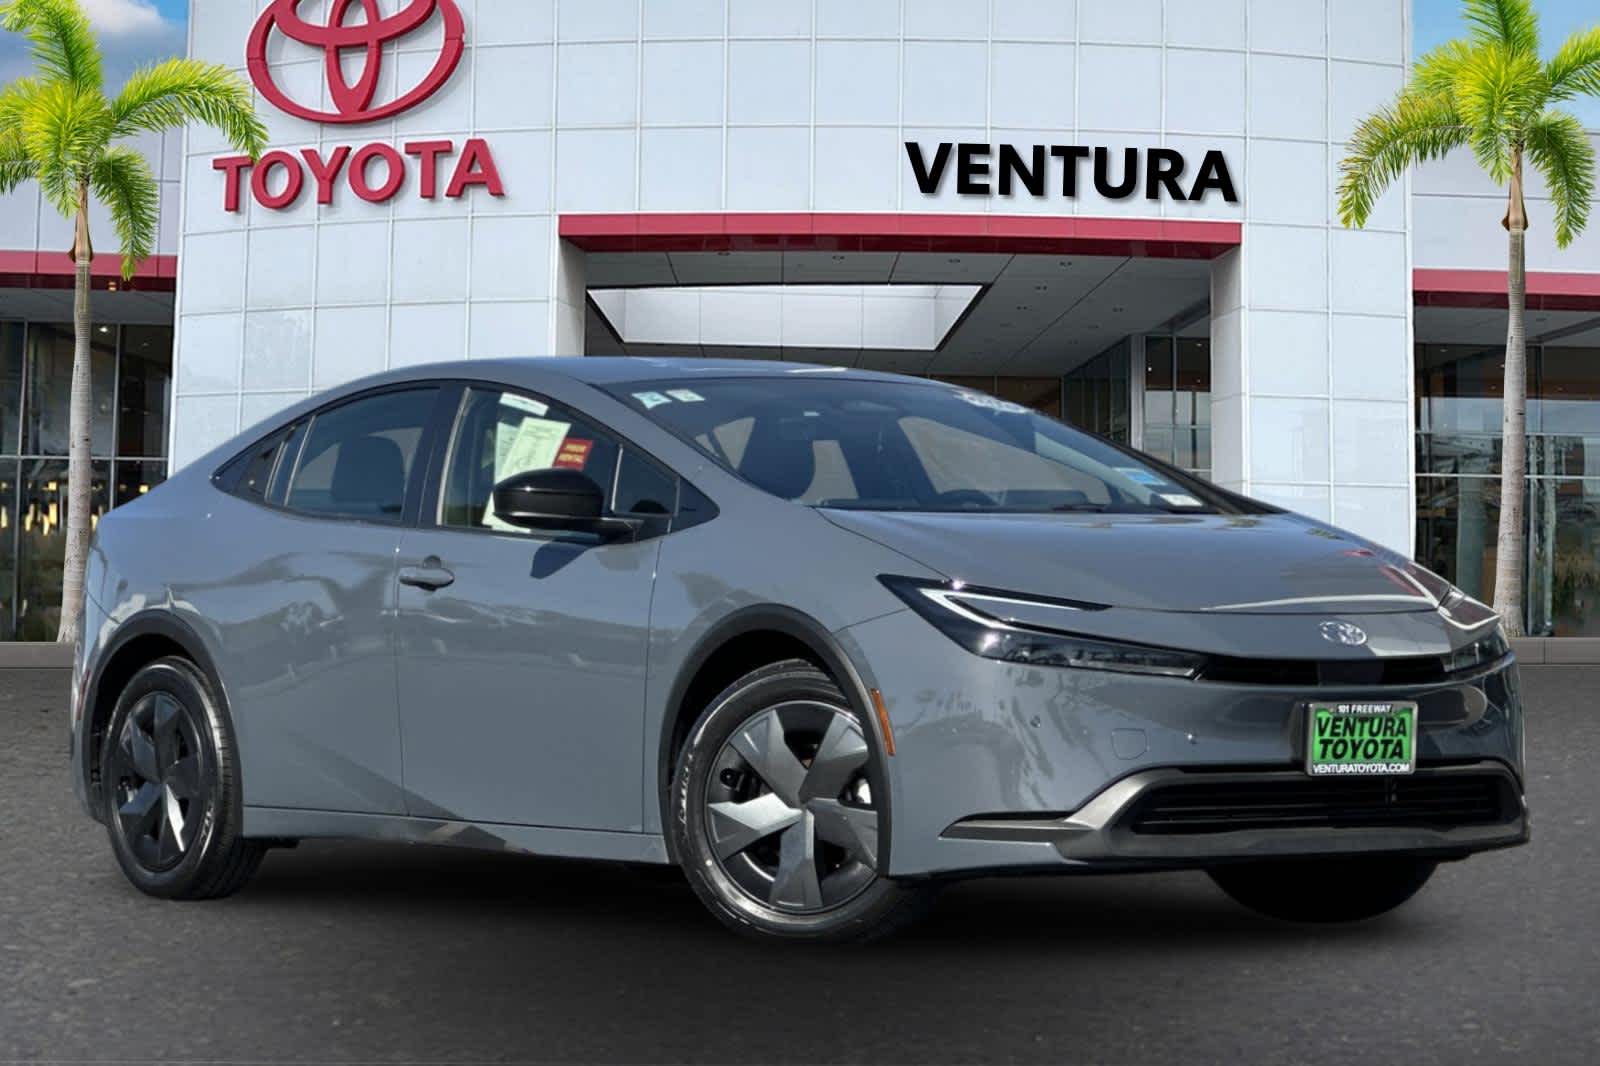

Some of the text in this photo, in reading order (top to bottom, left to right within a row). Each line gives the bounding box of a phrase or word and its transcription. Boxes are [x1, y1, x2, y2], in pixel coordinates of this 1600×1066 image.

[212, 138, 505, 212] TOYOTA
[904, 142, 1239, 203] VENTURA
[1351, 704, 1391, 713] FREEWAY
[1316, 716, 1407, 738] VENTURA
[1319, 738, 1404, 760] TOYOTA
[1313, 763, 1410, 774] VENTURATOYOTA.COM
